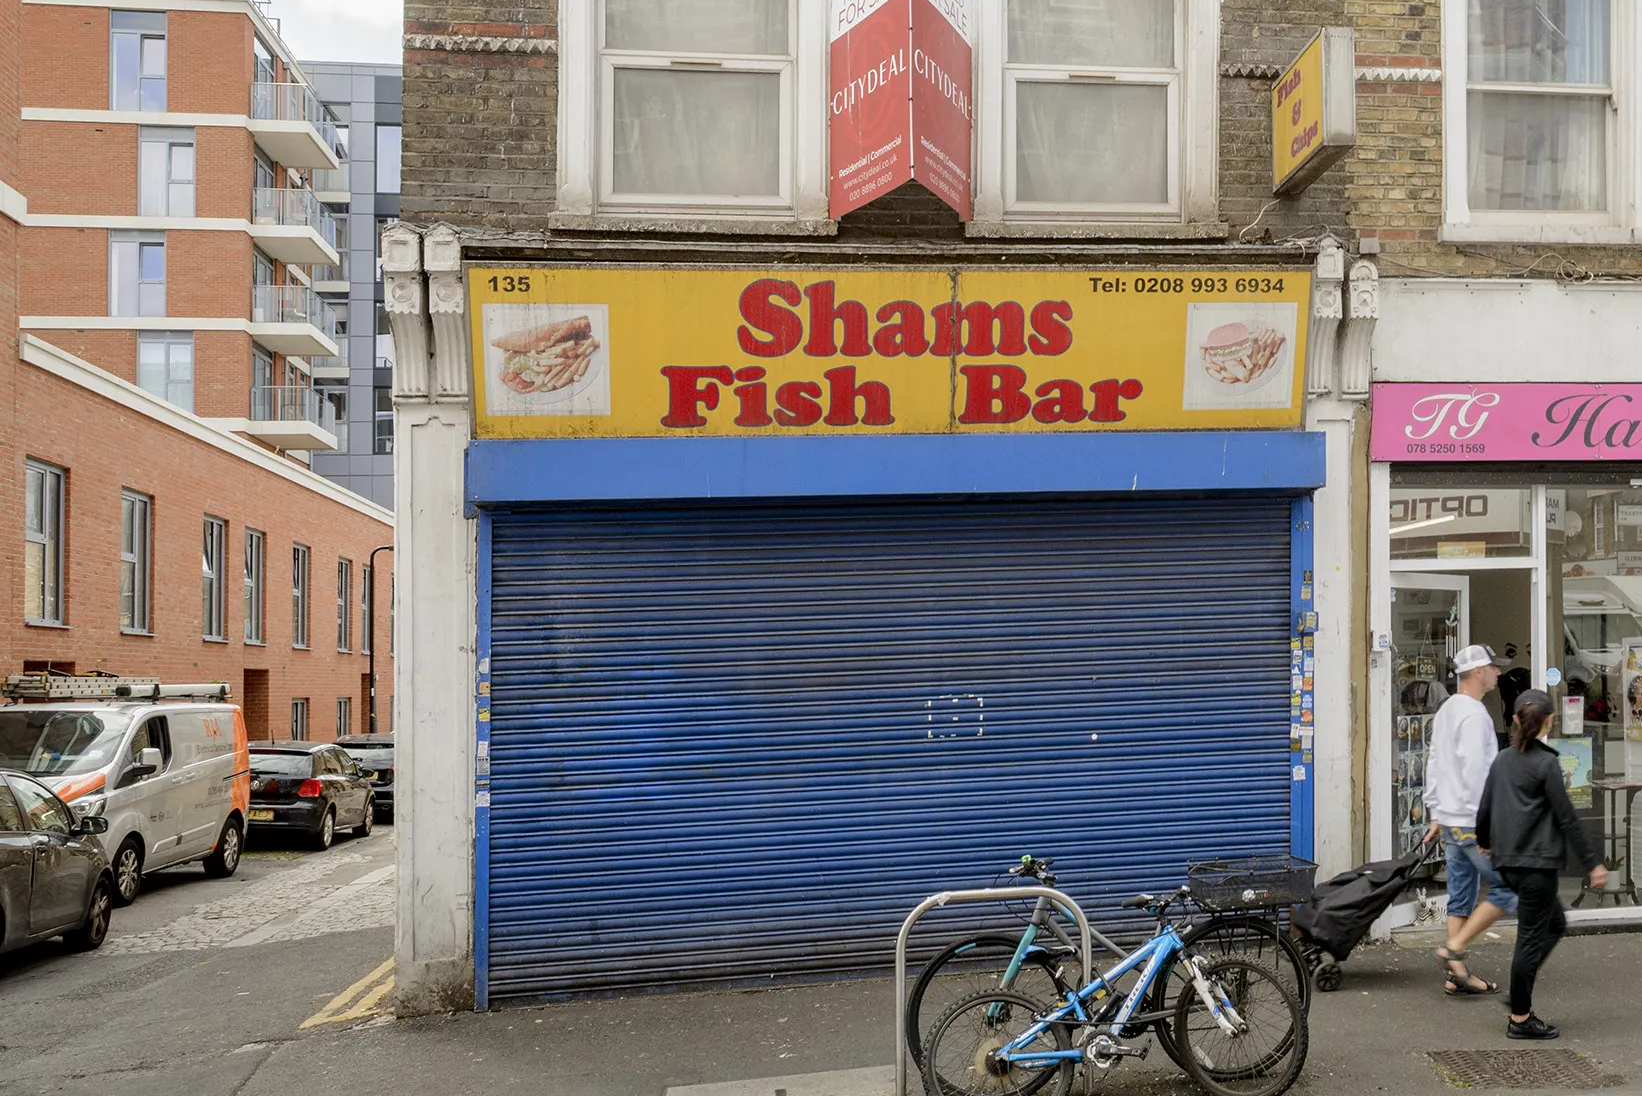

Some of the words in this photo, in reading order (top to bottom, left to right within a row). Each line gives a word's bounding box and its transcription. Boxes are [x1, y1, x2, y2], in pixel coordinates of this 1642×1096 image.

[833, 48, 907, 115] CITYDEAL
[914, 48, 970, 120] CITYDEAL
[1276, 67, 1301, 108] Fish
[838, 156, 868, 179] Residential
[870, 134, 903, 161] Commercial
[1290, 119, 1319, 158] Chips
[849, 188, 861, 202] 020
[877, 171, 893, 189] 0800
[487, 275, 532, 293] 135
[1089, 277, 1127, 293] Tel:
[1133, 277, 1185, 293] 0208
[1190, 278, 1228, 293] 993
[1235, 278, 1285, 293] 6934
[736, 277, 1075, 358] Shams
[659, 365, 897, 428] Fish
[957, 363, 1143, 424] Bar
[1406, 442, 1427, 454] 078
[1429, 442, 1456, 454] 5250
[1459, 442, 1486, 454] 1569
[1419, 664, 1436, 674] OPEN
